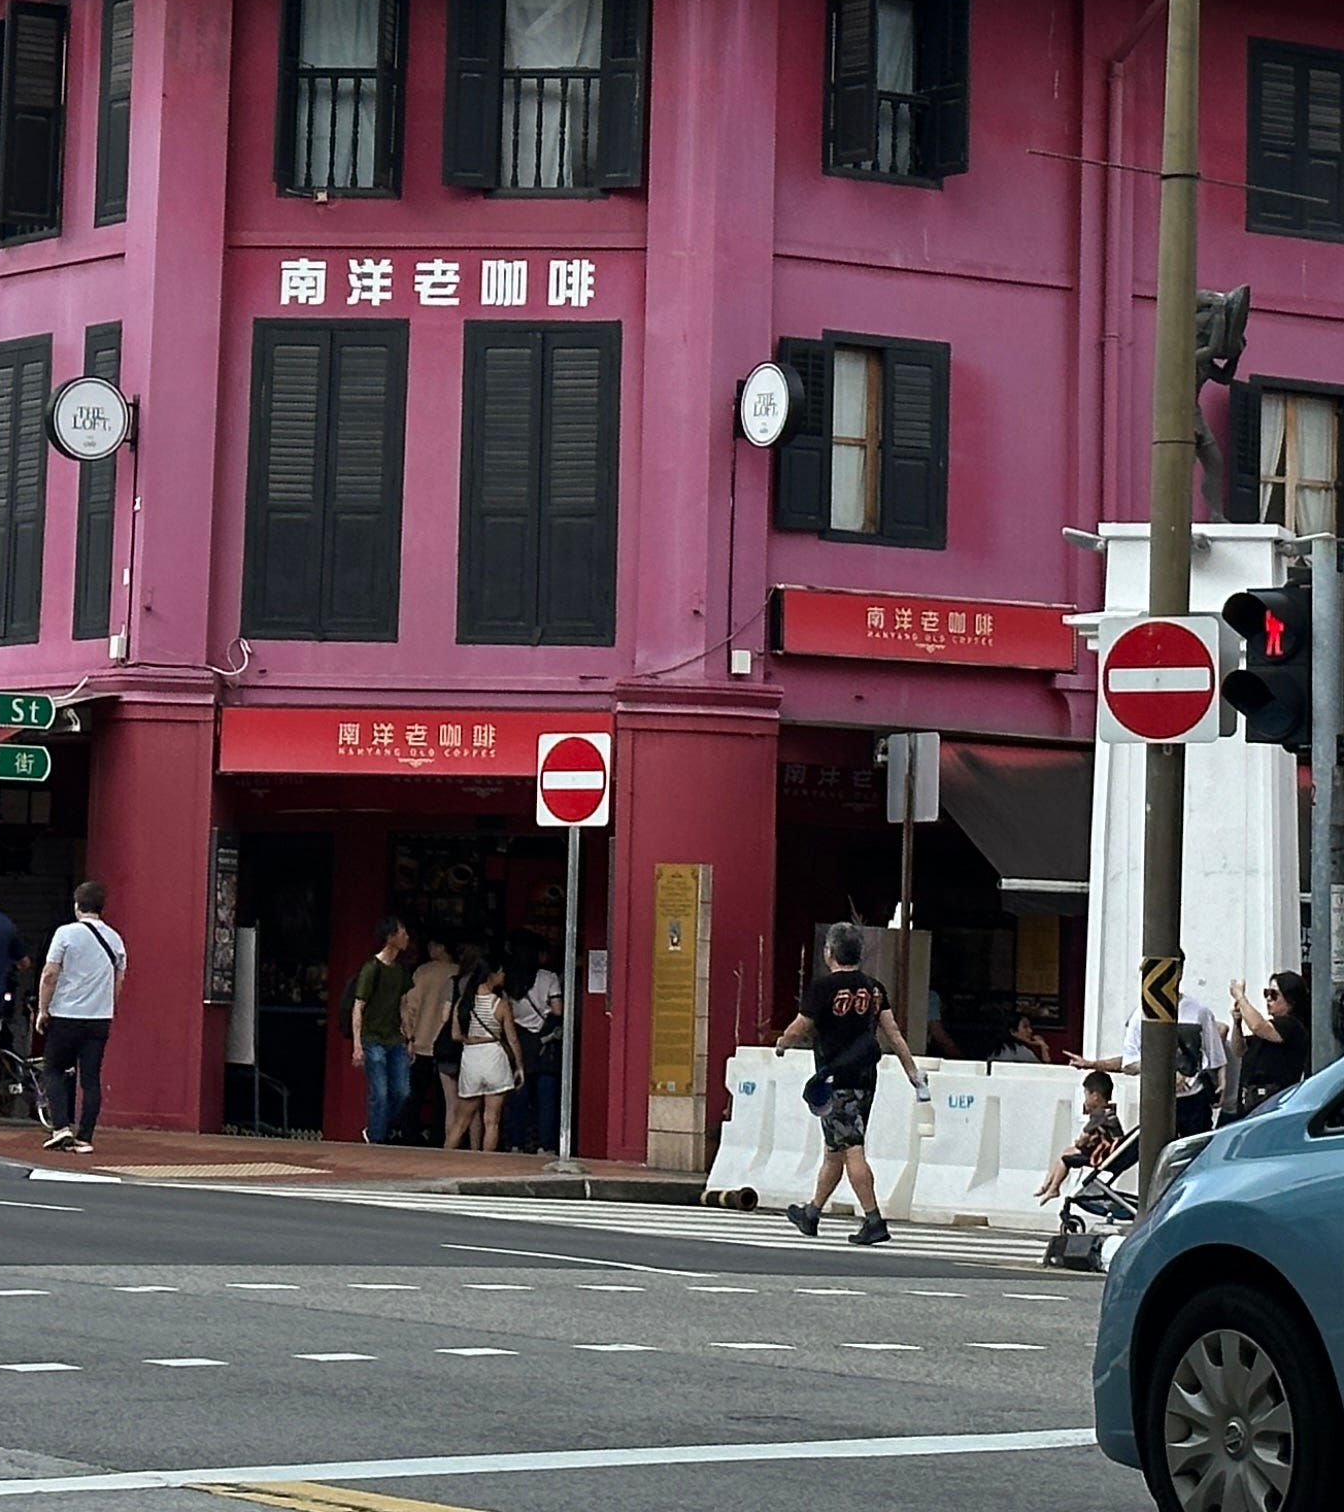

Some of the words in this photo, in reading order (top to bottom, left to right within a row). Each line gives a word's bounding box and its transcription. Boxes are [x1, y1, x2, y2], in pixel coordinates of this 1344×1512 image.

[280, 258, 596, 307] 南洋老咖啡
[866, 606, 993, 635] 南洋老咖啡
[11, 697, 41, 725] St
[338, 722, 496, 748] 南洋老咖啡
[948, 1095, 974, 1108] UEP
